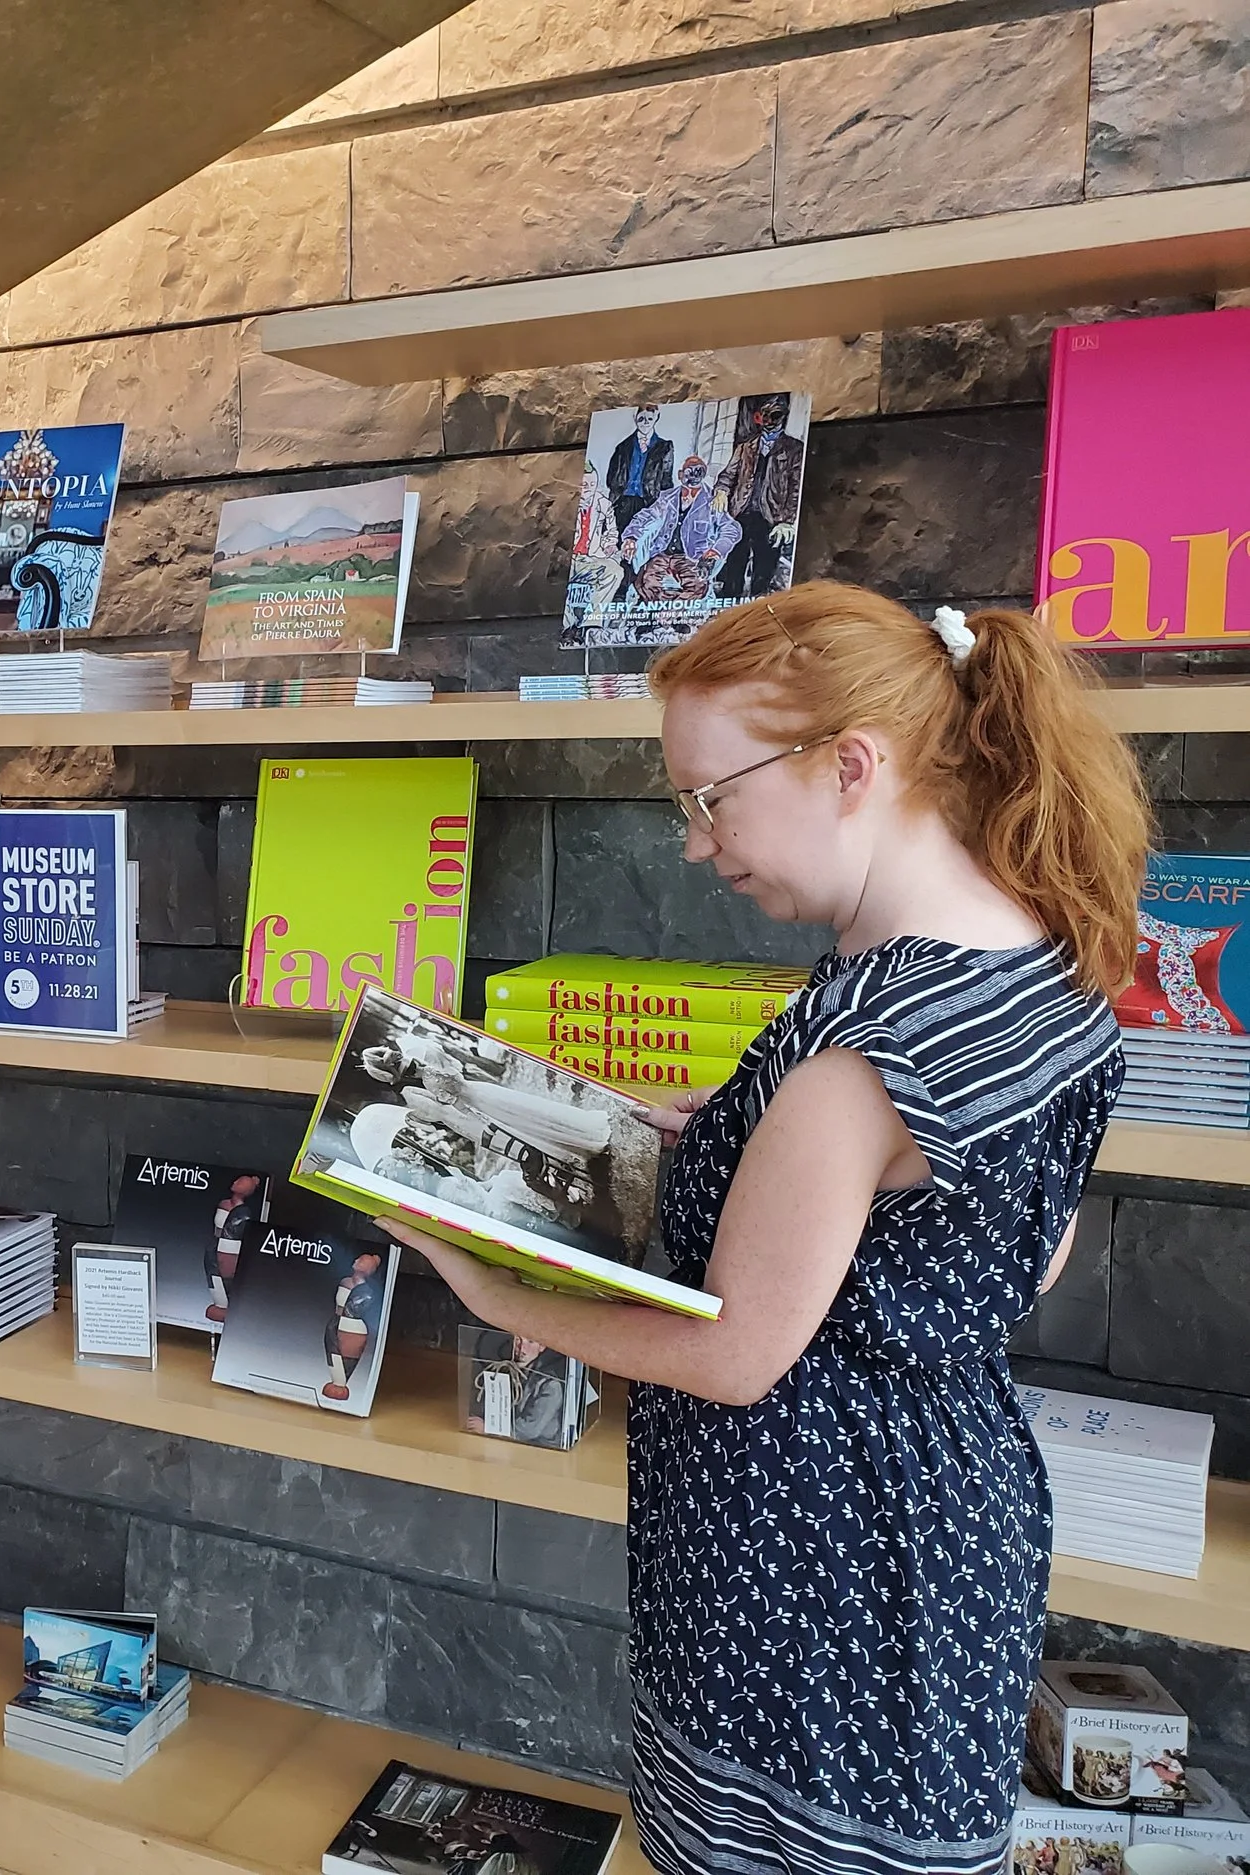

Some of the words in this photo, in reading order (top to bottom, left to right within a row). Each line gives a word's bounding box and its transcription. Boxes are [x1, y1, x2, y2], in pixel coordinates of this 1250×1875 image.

[55, 502, 63, 512] by
[259, 590, 299, 605] FROM
[303, 588, 345, 602] SPAIN
[253, 605, 274, 619] TO
[278, 602, 346, 617] VIRGINIA
[584, 602, 594, 612] A
[601, 602, 633, 612] VERY
[636, 600, 701, 611] ANXIOUS
[677, 609, 718, 617] AMERICAN
[272, 768, 289, 779] DK
[2, 847, 95, 875] MUSEUM
[1159, 874, 1187, 882] WAYS
[1208, 877, 1240, 885] WEAR
[2, 877, 96, 915] STORE
[1141, 881, 1250, 905] SCARF
[4, 951, 20, 963] BE
[26, 952, 35, 964] A
[41, 953, 97, 966] PATRON
[48, 983, 98, 1000] 11.28.21
[547, 980, 692, 1018] fashion
[761, 1000, 775, 1020] DK
[547, 1012, 692, 1052] fashion
[137, 1157, 210, 1190] Artemis
[260, 1229, 332, 1265] Artemis
[1047, 1416, 1069, 1430] OF
[1081, 1408, 1110, 1436] PLACE
[1079, 1716, 1106, 1729] Brief
[1109, 1718, 1151, 1734] History
[1160, 1722, 1180, 1734] Art
[1025, 1817, 1051, 1830] Brief
[1054, 1819, 1093, 1834] History
[1104, 1821, 1124, 1833] Art
[1144, 1823, 1172, 1836] Brief
[1174, 1825, 1215, 1841] History
[1224, 1829, 1244, 1841] Art
